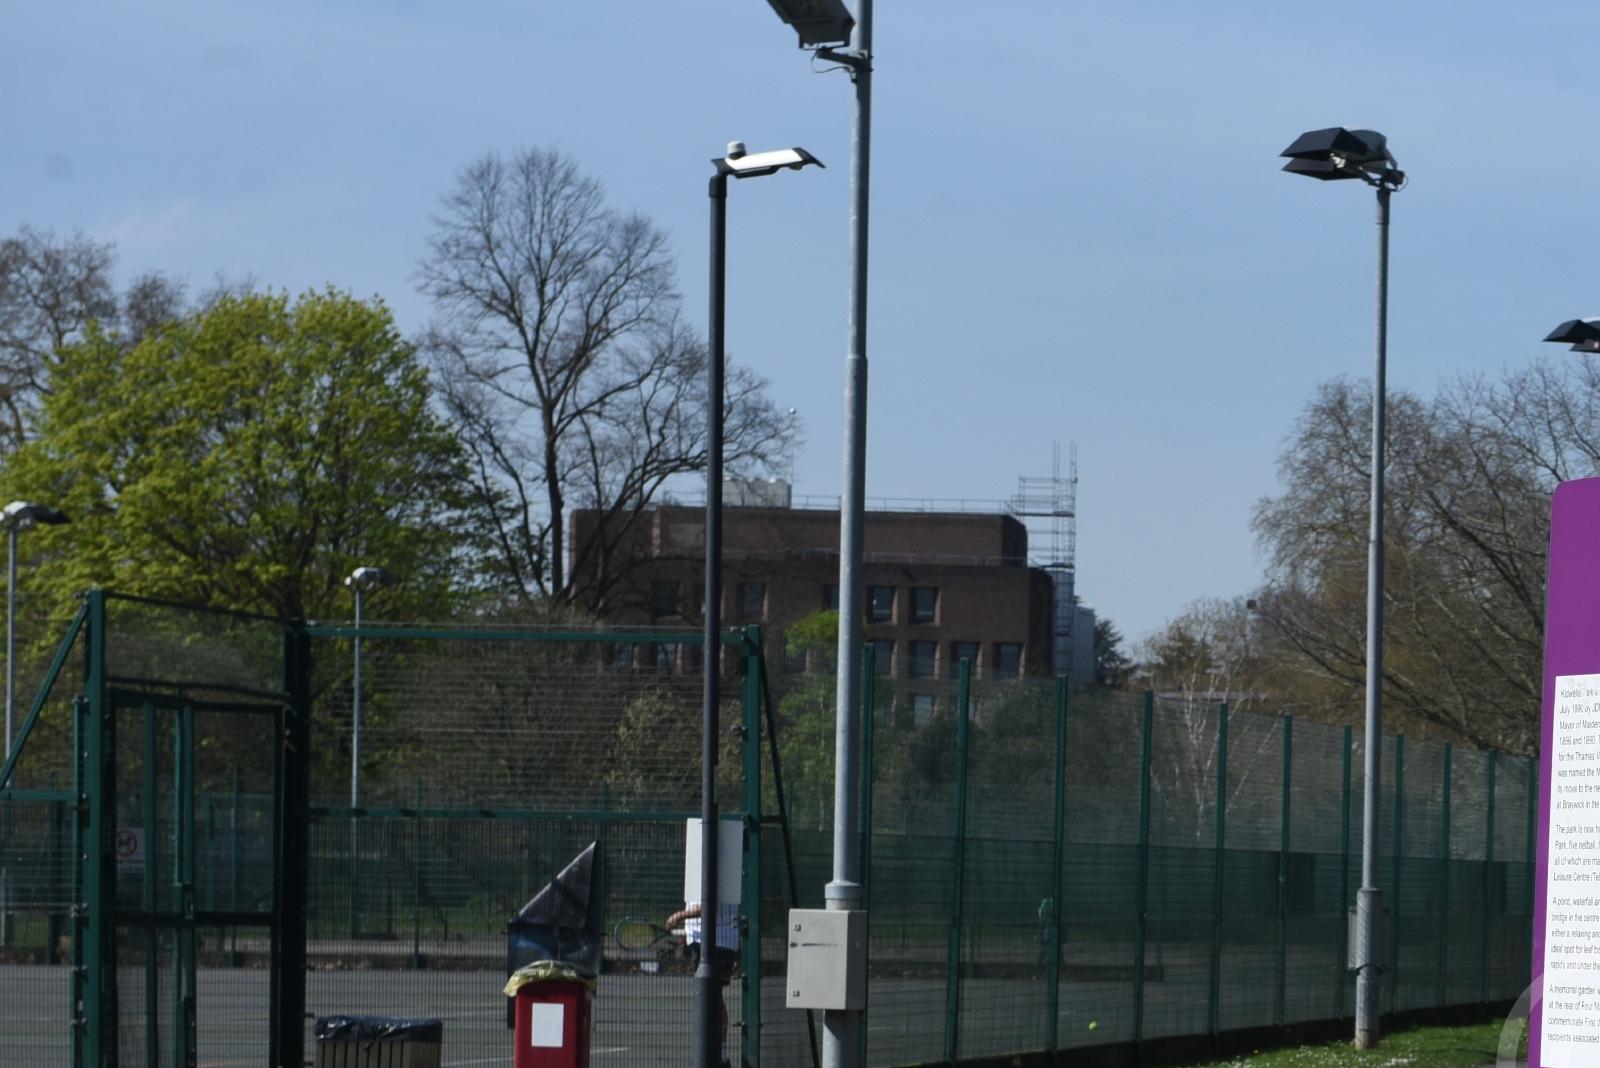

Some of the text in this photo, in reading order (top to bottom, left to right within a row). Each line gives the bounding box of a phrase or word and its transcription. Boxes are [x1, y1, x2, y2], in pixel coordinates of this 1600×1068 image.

[1569, 768, 1586, 777] named
[1587, 767, 1595, 776] the
[1557, 800, 1561, 809] at
[1586, 800, 1590, 809] in
[1556, 825, 1565, 833] The
[1566, 825, 1577, 836] park
[1550, 984, 1554, 993] A
[1578, 985, 1596, 997] garden
